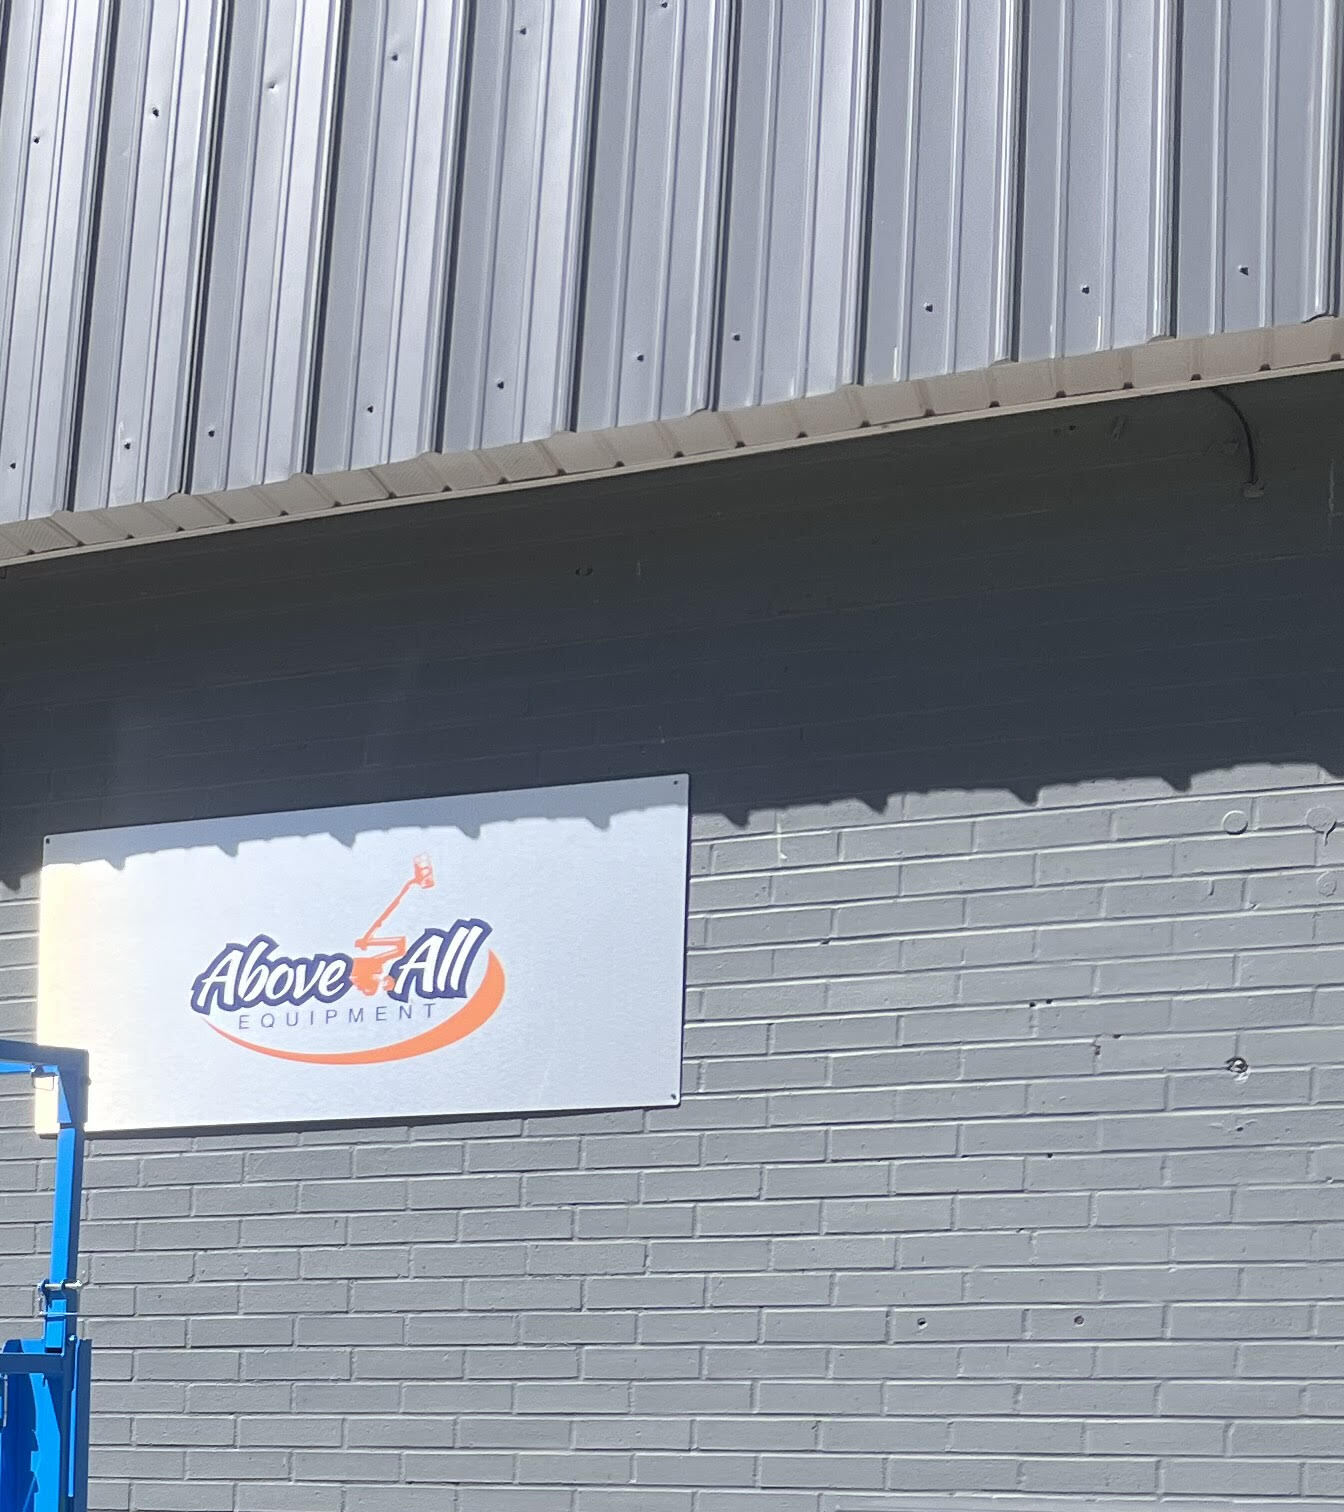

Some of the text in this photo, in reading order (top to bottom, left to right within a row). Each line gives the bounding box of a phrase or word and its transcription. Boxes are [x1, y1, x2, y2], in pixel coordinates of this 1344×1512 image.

[191, 919, 492, 1014] Above All
[238, 1002, 436, 1030] EQUIPMENT
